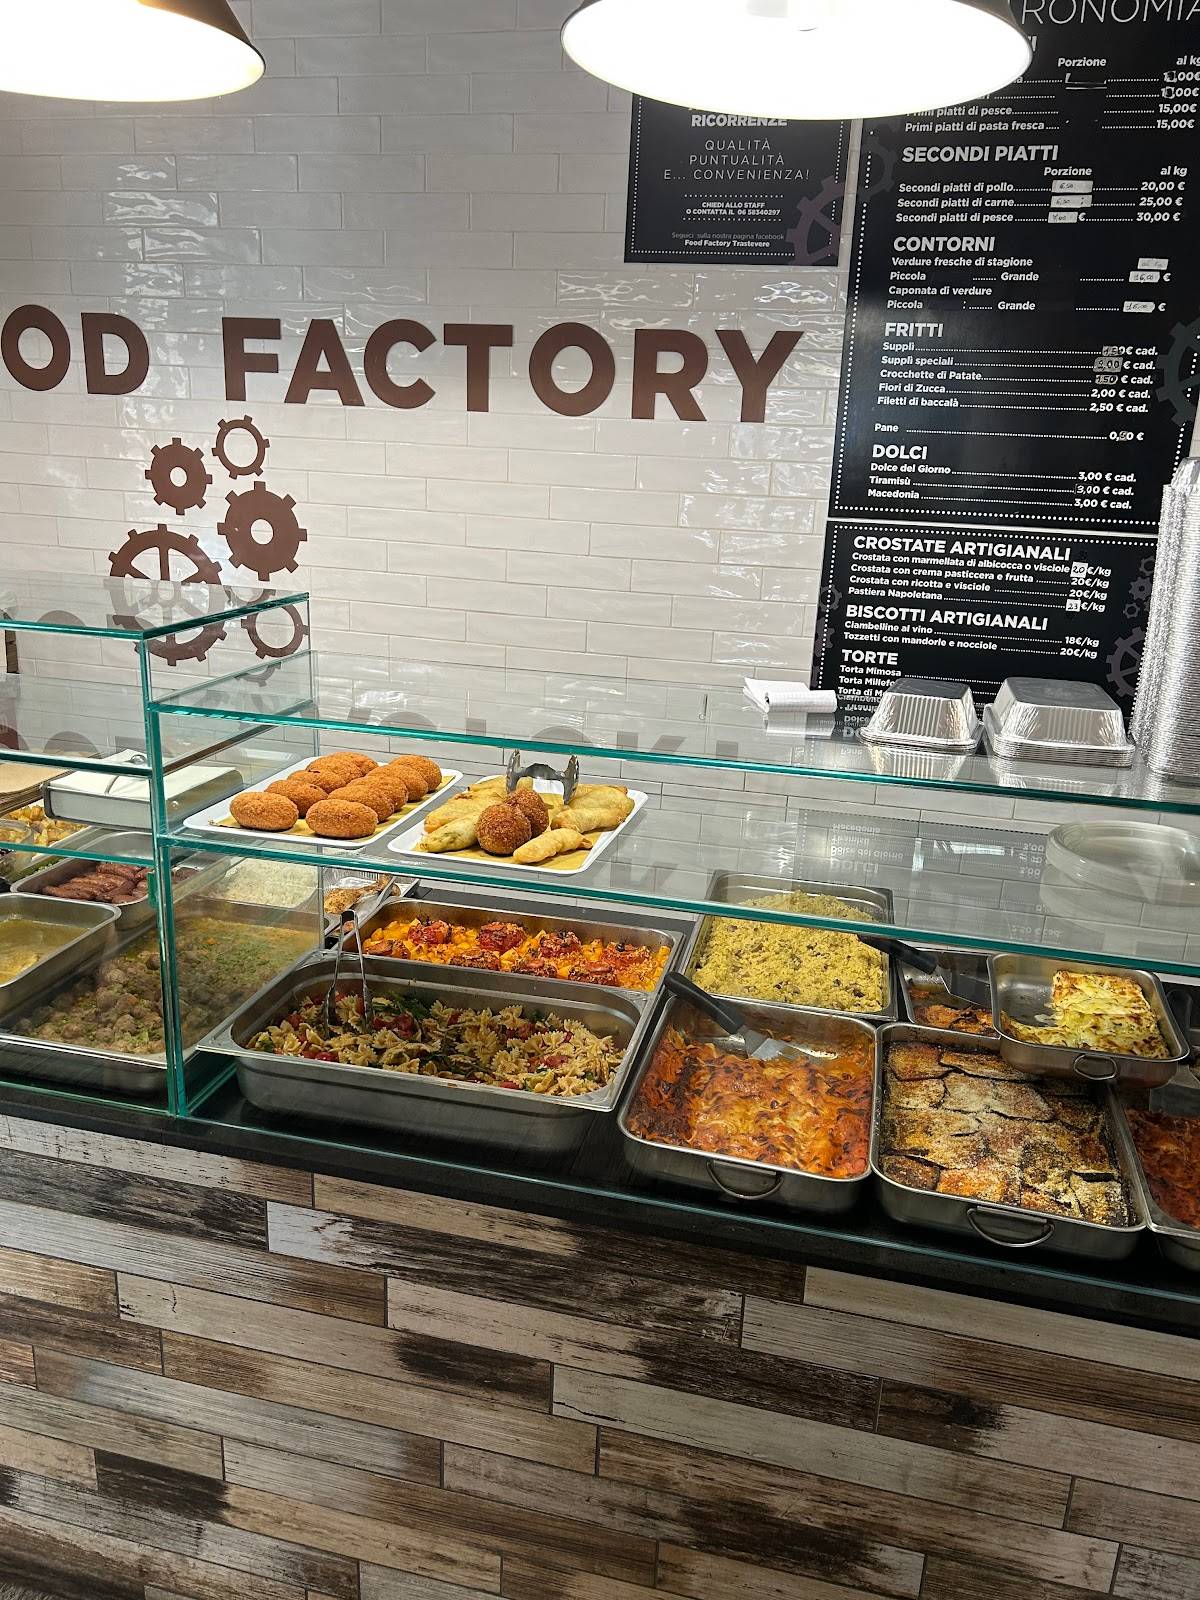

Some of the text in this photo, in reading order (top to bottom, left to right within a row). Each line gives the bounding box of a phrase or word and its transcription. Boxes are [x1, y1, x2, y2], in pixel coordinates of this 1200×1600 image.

[1058, 55, 1187, 67] Porzione al
[968, 106, 978, 115] di
[981, 107, 1012, 117] pesce
[1159, 103, 1197, 114] 15,00€
[905, 119, 1195, 133] Primi piatti di pasta fresca 15,00€
[705, 138, 770, 150] QUALITÀ
[690, 152, 784, 165] PUNTUALITÀ
[902, 145, 1058, 162] SECONDI PIATTI
[694, 169, 809, 180] CONVENIENZA!
[1044, 166, 1187, 177] Porzione al kg
[899, 181, 1185, 193] Secondi piatti di pollo 20,00 €
[897, 198, 939, 207] Secondi
[941, 198, 969, 209] piatti
[972, 197, 982, 207] di
[1139, 197, 1172, 208] 25,00
[1175, 197, 1183, 206] €
[896, 212, 1181, 223] Secondi piatti di pesce 30,00 €
[894, 237, 995, 251] CONTORNI
[892, 257, 1033, 268] Verdure fresche di stagione
[890, 271, 1039, 281] Piccola Grande
[889, 286, 992, 296] Caponata di verdure
[887, 300, 1035, 310] Piccola Grande
[885, 322, 943, 337] FRITTI
[1135, 346, 1158, 355] cad.
[222, 316, 804, 423] FACTORY
[881, 356, 1155, 370] Supplì speciali cad.
[880, 369, 935, 380] Crocchette
[937, 370, 947, 380] di
[949, 371, 982, 380] Patate
[1131, 375, 1153, 384] cad.
[879, 383, 1150, 398] Fiori di Zucca 2,00 € cad.
[877, 396, 1148, 413] Filetti di baccalà 2,50 € cad.
[875, 423, 899, 432] Pane
[872, 444, 927, 460] DOLCI
[871, 463, 1136, 482] Dolce del Giorno 3,00 € cad.
[869, 476, 911, 485] Tiramisù
[1102, 486, 1110, 494] €
[1112, 487, 1134, 495] cad.
[868, 489, 1132, 509] Macedonia 3,00 € cad.
[854, 536, 1070, 561] CROSTATE ARTIGIANALI
[852, 552, 891, 562] Crostata
[911, 557, 964, 566] marmellata
[966, 559, 976, 567] di
[978, 560, 1023, 570] albicocca
[1034, 563, 1070, 573] visciole
[851, 564, 891, 573] Crostata
[944, 570, 994, 580] pasticcera
[1005, 573, 1033, 582] frutta
[1071, 578, 1109, 589] 20€/kg
[848, 587, 942, 600] Pastiera Napoletana
[850, 575, 889, 585] Crostata
[911, 579, 943, 588] ricotta
[954, 582, 990, 591] visciole
[1069, 589, 1107, 600] 20€/kg
[846, 604, 1048, 631] BISCOTTI ARTIGIANALI
[845, 621, 899, 631] Ciambelline
[912, 625, 933, 634] vino
[1065, 636, 1099, 647] 18€/kg
[844, 632, 880, 641] Tozzetti
[902, 637, 946, 646] mandorle
[957, 641, 997, 650] nocciole
[1060, 648, 1097, 659] 20€/kg
[842, 649, 898, 665] TORTE
[840, 665, 901, 676] Torta Mimosa
[839, 676, 862, 684] Torta
[838, 686, 861, 695] Torta
